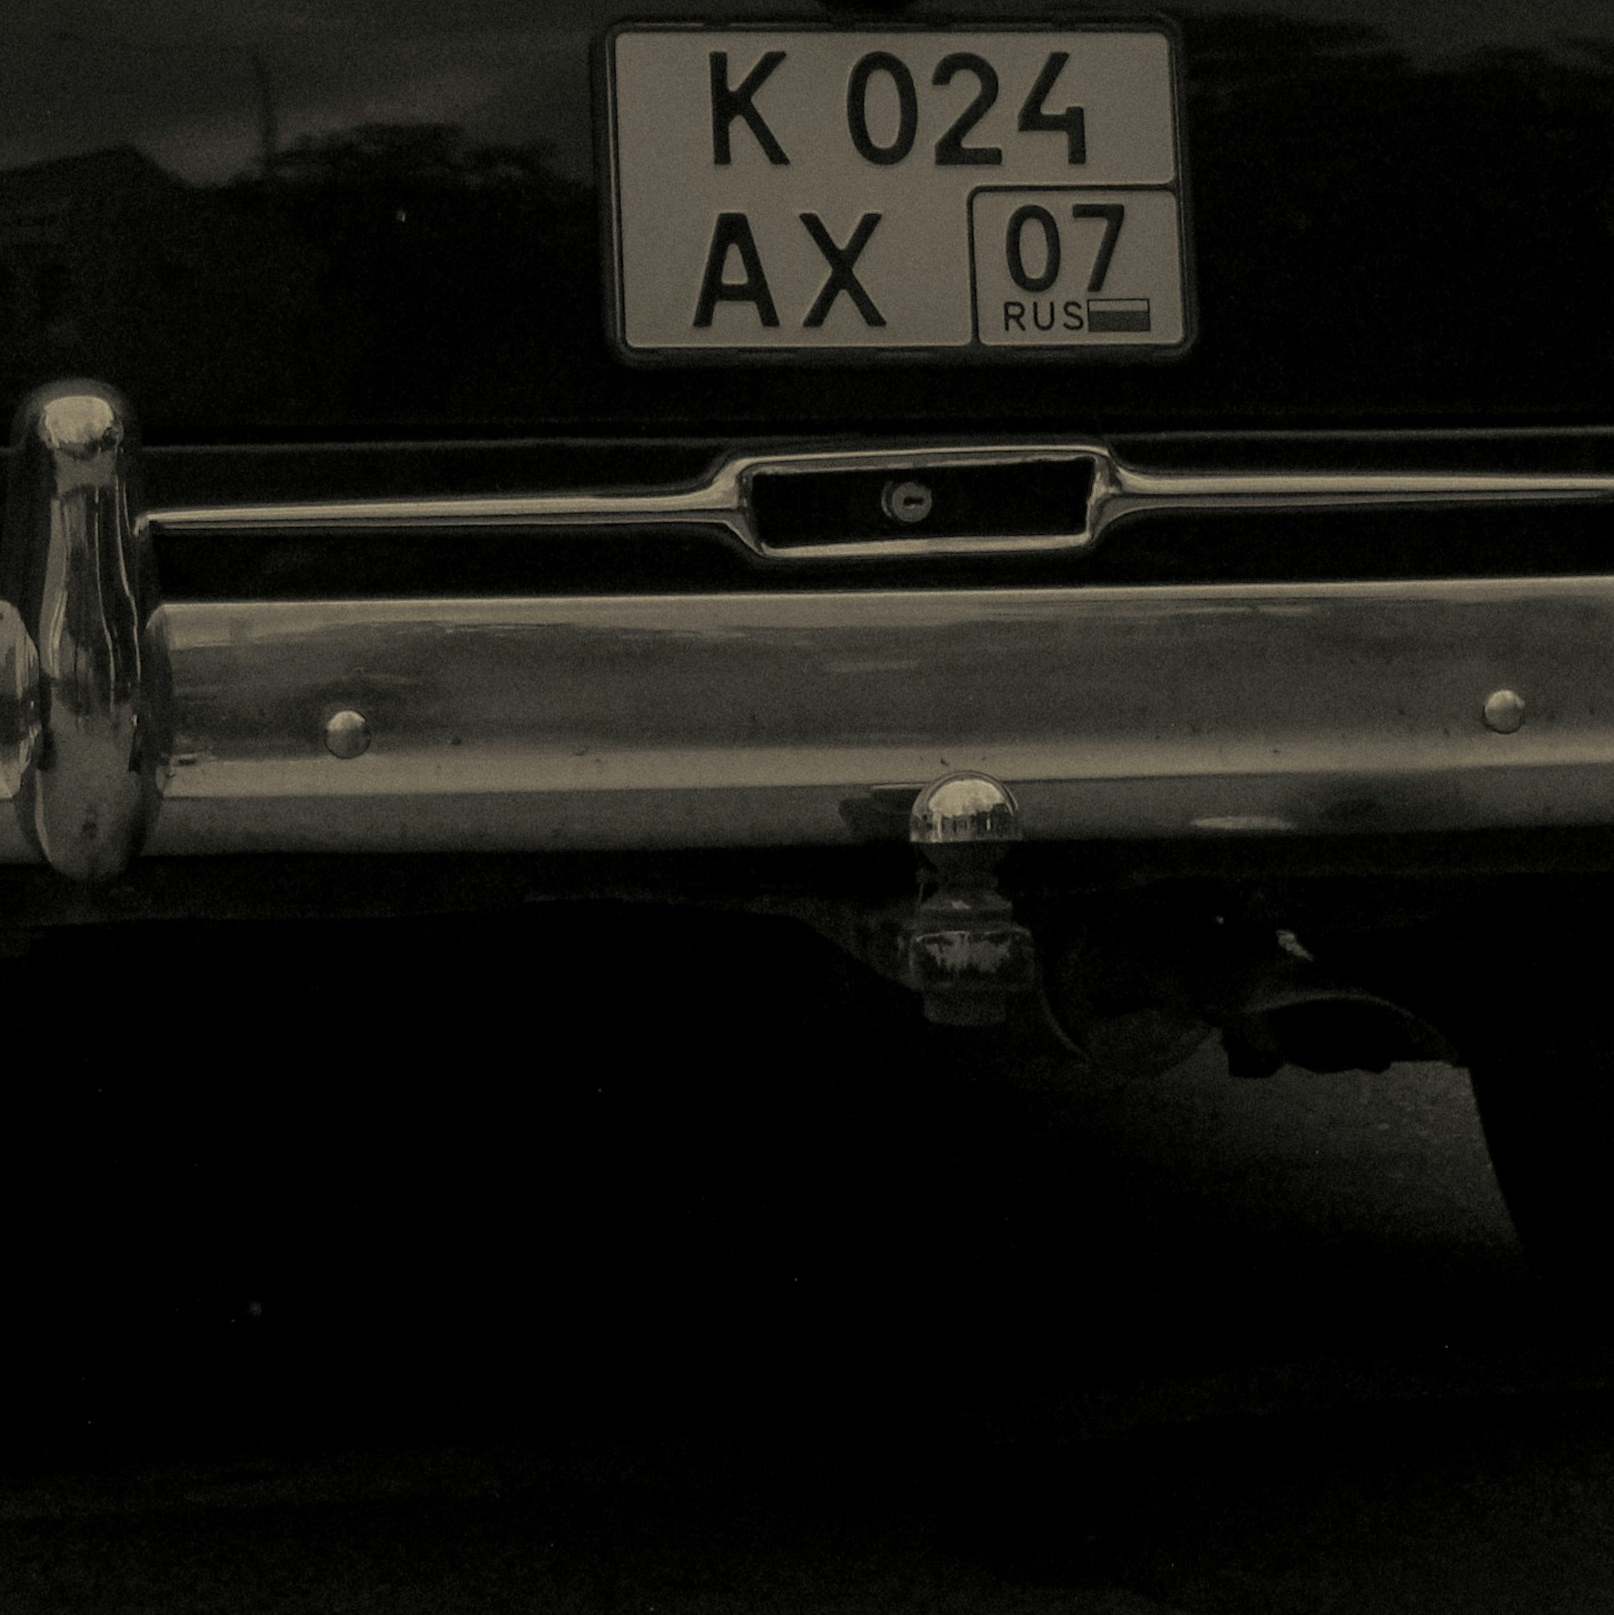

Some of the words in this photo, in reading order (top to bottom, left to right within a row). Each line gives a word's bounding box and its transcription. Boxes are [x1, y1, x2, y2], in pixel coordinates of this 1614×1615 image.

[846, 50, 1087, 166] 024
[1005, 203, 1125, 293] 07
[1003, 300, 1084, 332] RUS
